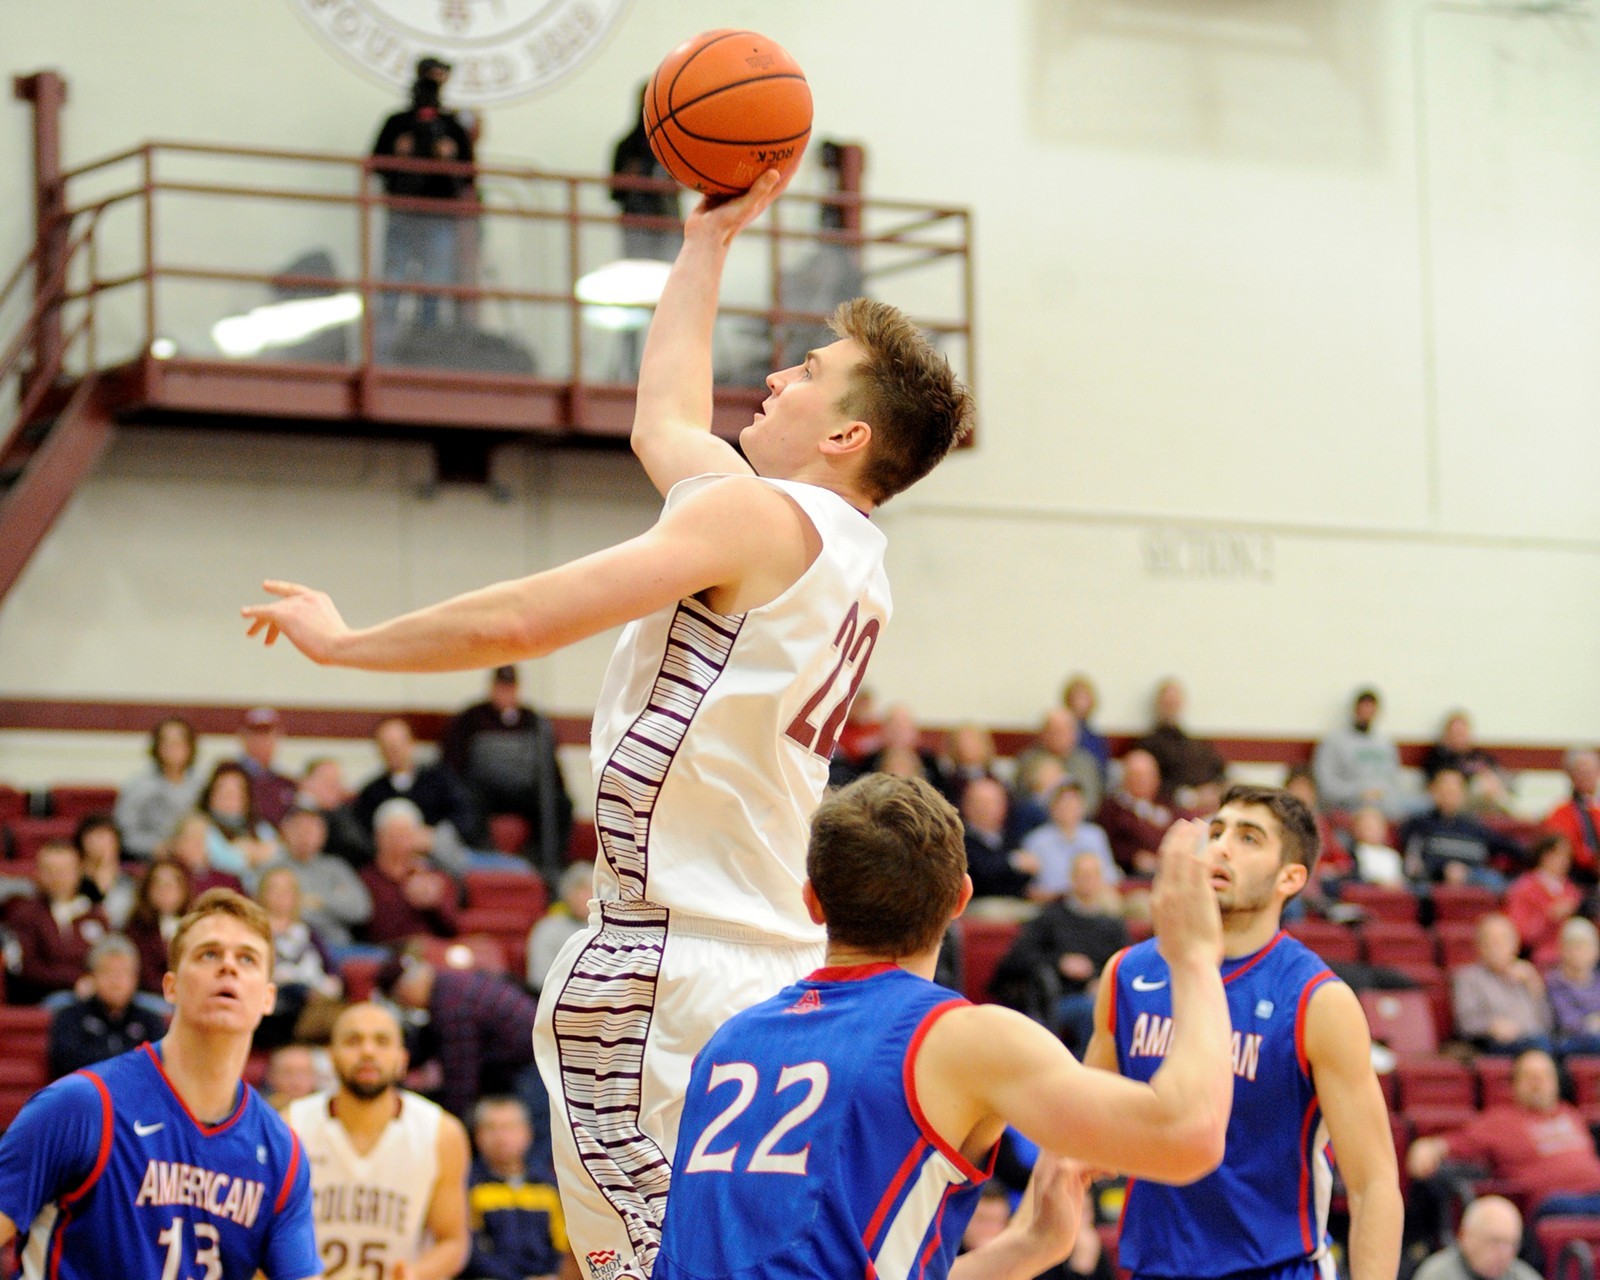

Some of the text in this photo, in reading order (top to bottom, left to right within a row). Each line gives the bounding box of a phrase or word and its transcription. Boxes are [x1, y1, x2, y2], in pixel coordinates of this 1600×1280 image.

[757, 147, 794, 163] ROCK
[784, 601, 880, 760] 22
[1129, 1012, 1263, 1082] AMAN
[684, 1061, 830, 1176] 22
[135, 1159, 266, 1229] AMERICAN
[157, 1217, 223, 1280] 13
[321, 1238, 388, 1280] 25
